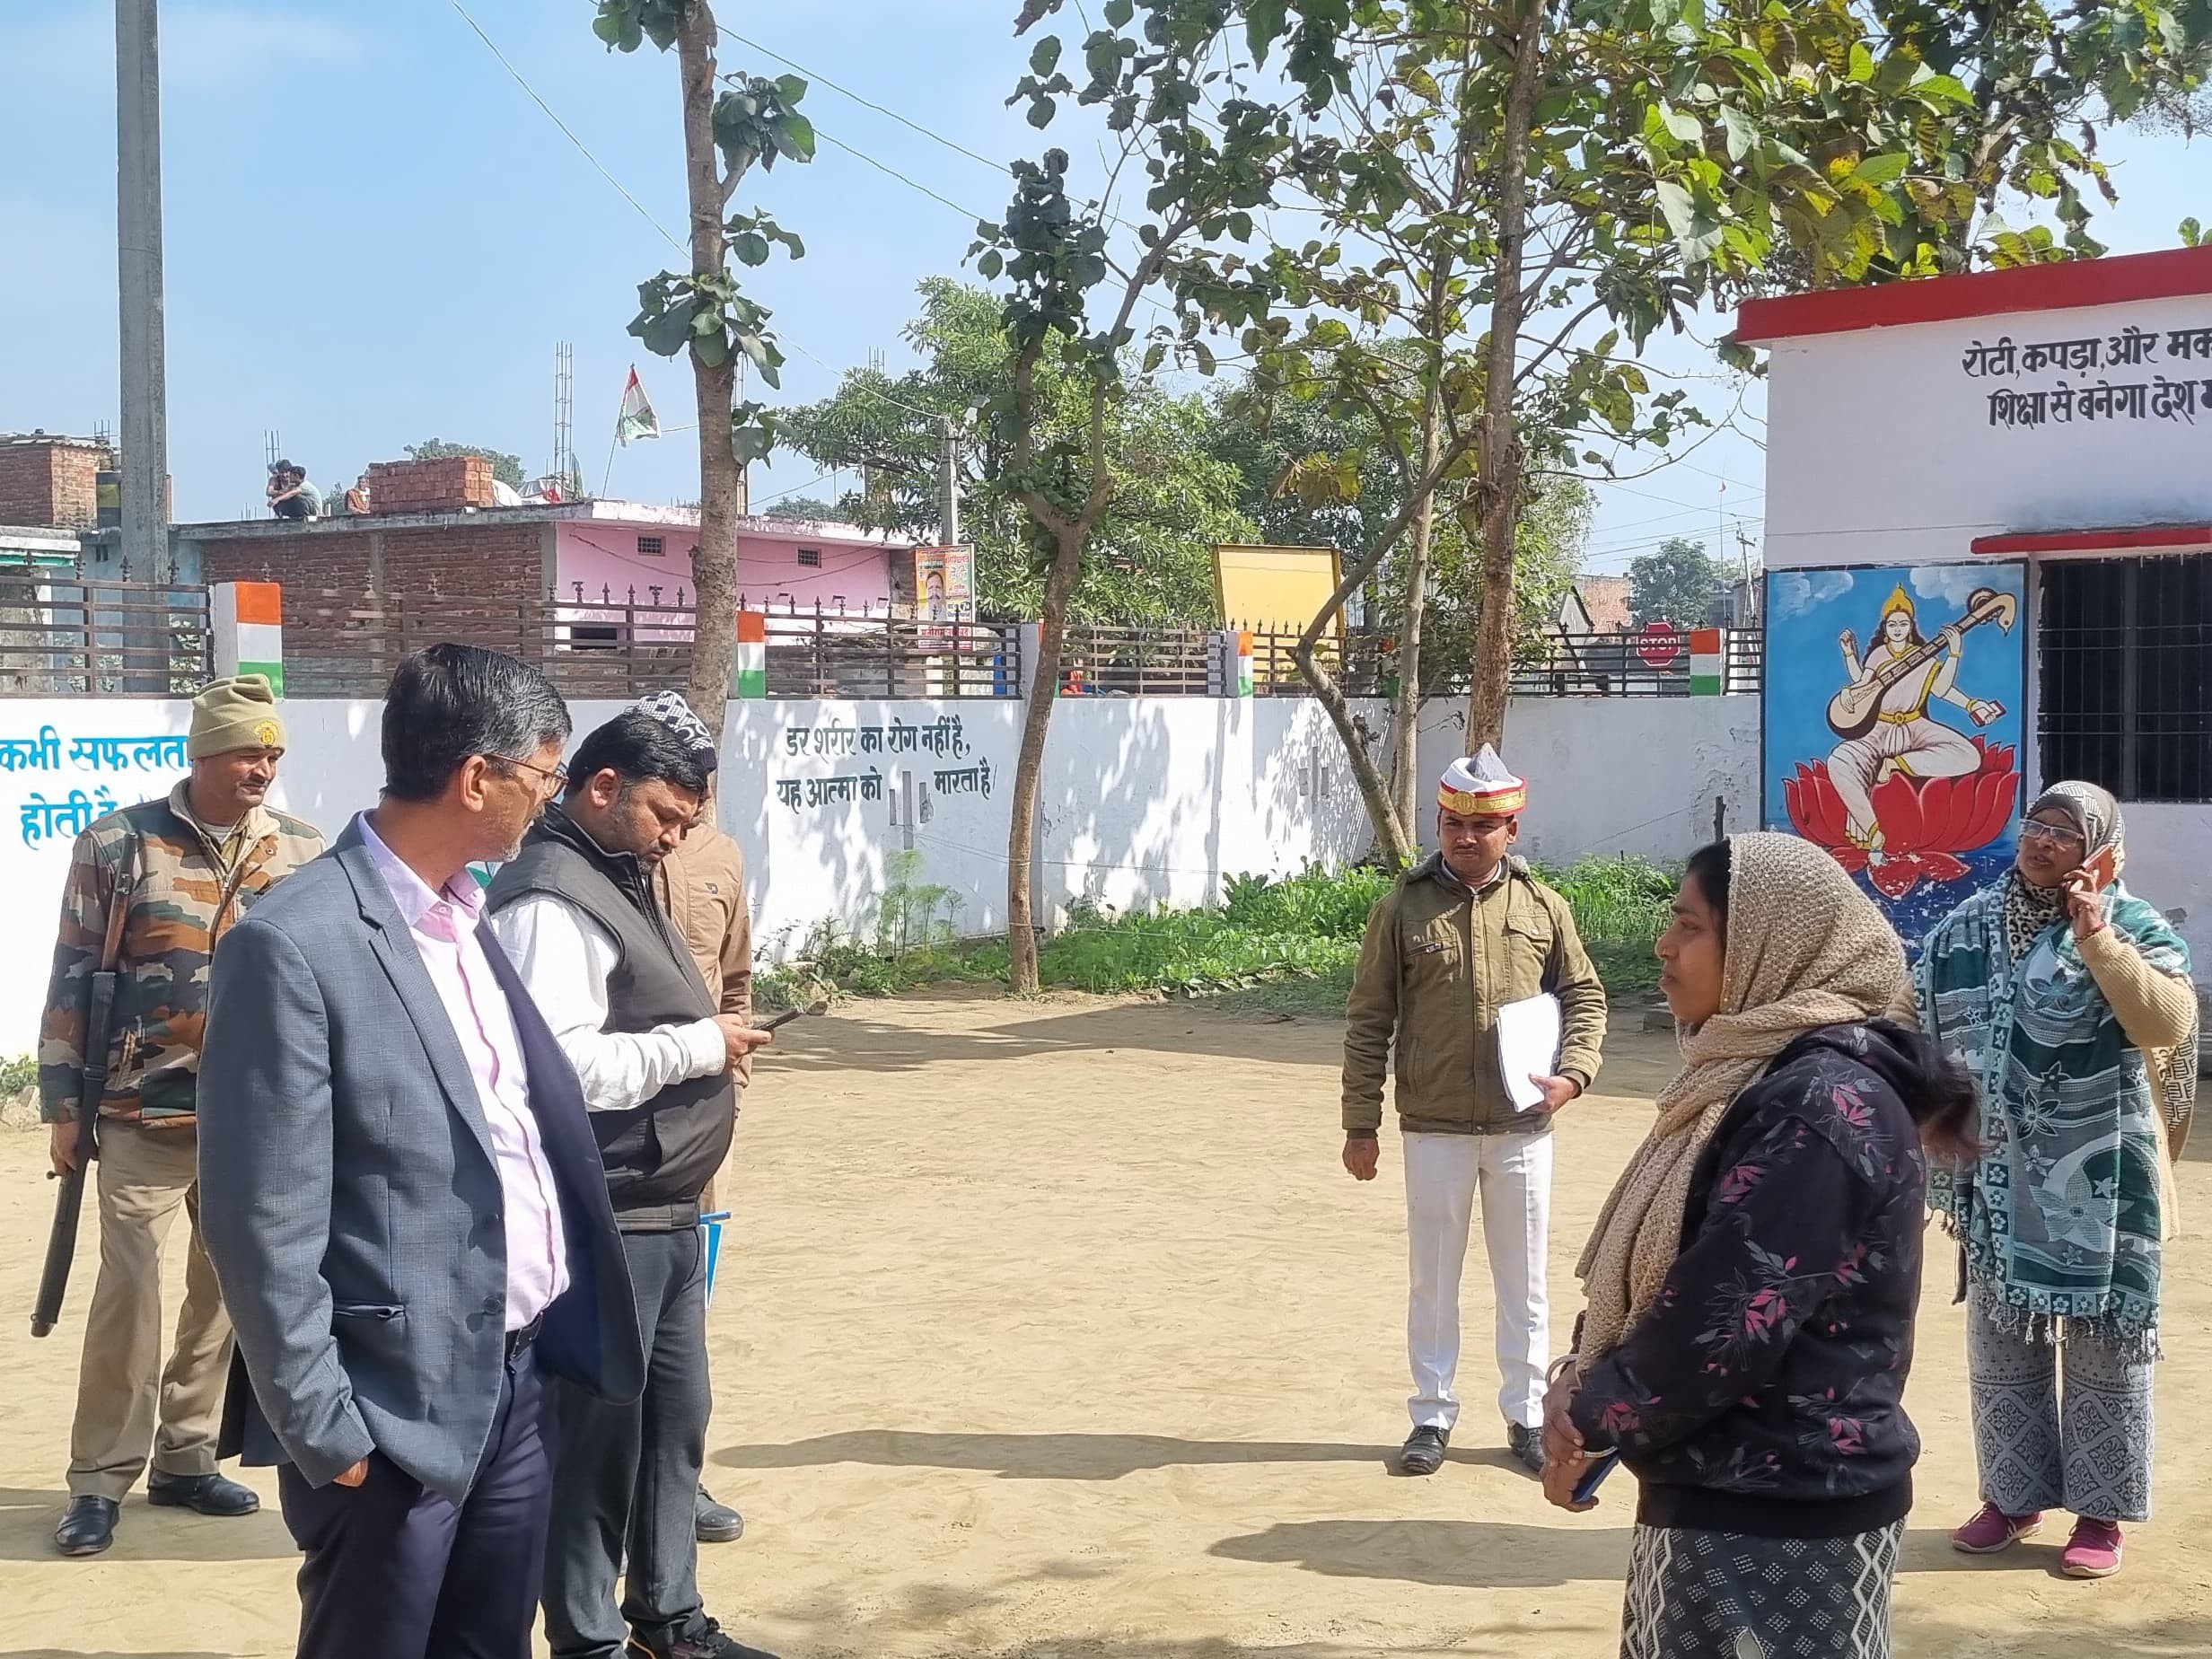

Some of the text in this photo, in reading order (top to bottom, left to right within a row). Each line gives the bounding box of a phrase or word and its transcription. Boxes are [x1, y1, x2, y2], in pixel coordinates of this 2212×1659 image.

[2105, 326, 2160, 364] और
[1987, 388, 2048, 430] शिक्षा
[2050, 381, 2076, 423] से
[2077, 380, 2148, 421] बनेगा
[2151, 375, 2199, 426] देश
[1639, 637, 1677, 651] STOP
[0, 725, 192, 772] कभी सफलत
[786, 727, 810, 756] डर
[814, 718, 856, 763] शरीर
[860, 727, 883, 753] का
[888, 716, 917, 754] रोग
[922, 715, 951, 759] नहीं
[777, 779, 802, 814] यह
[805, 776, 857, 808] आत्मा
[860, 766, 882, 801] को
[934, 767, 979, 794] मारता
[21, 790, 92, 850] होती
